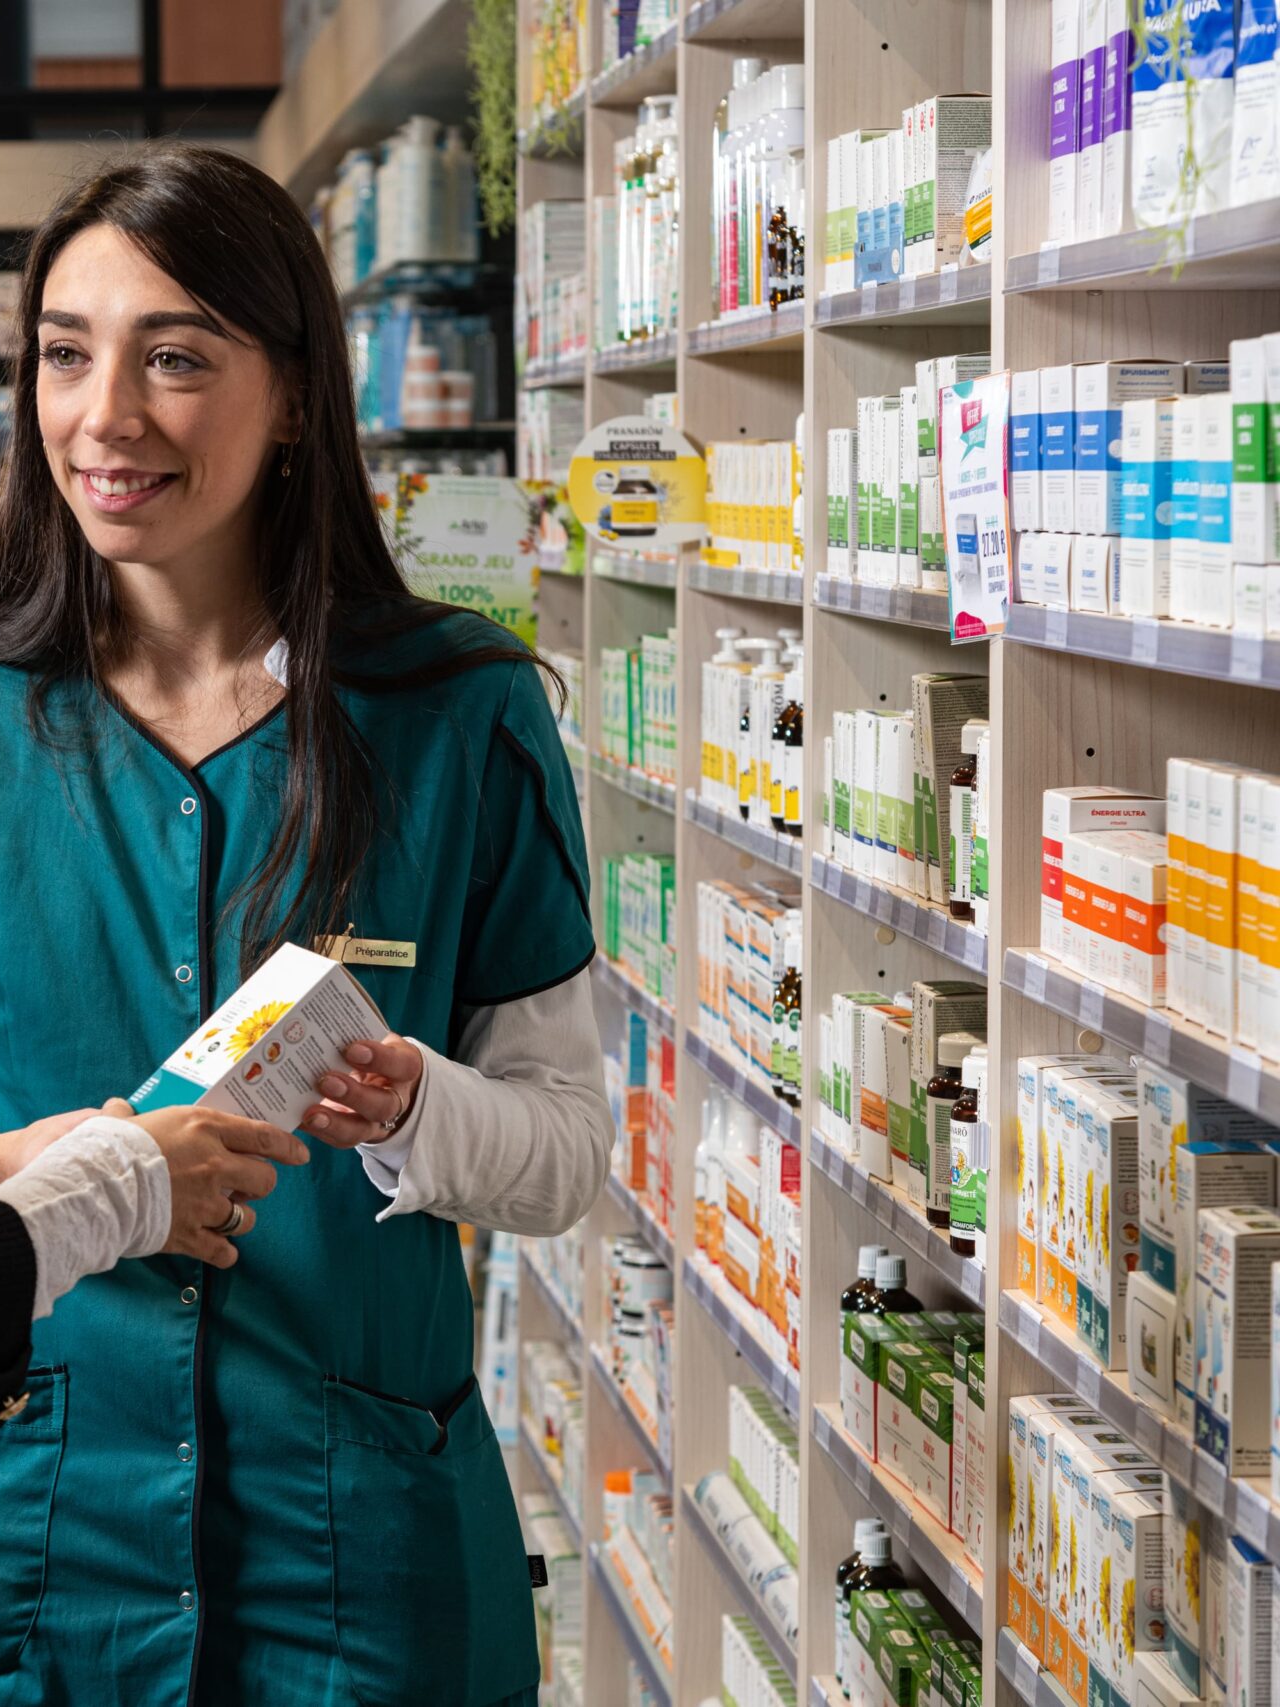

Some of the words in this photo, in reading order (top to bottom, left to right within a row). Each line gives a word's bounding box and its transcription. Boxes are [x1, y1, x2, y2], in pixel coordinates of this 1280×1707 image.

[1120, 367, 1170, 376] ÉPUISEMENT
[483, 554, 514, 570] JEU
[438, 584, 495, 604] 100%
[1090, 808, 1122, 817] ÉNERGIE
[1123, 809, 1147, 817] ULTRA
[355, 946, 408, 958] Préparatrice
